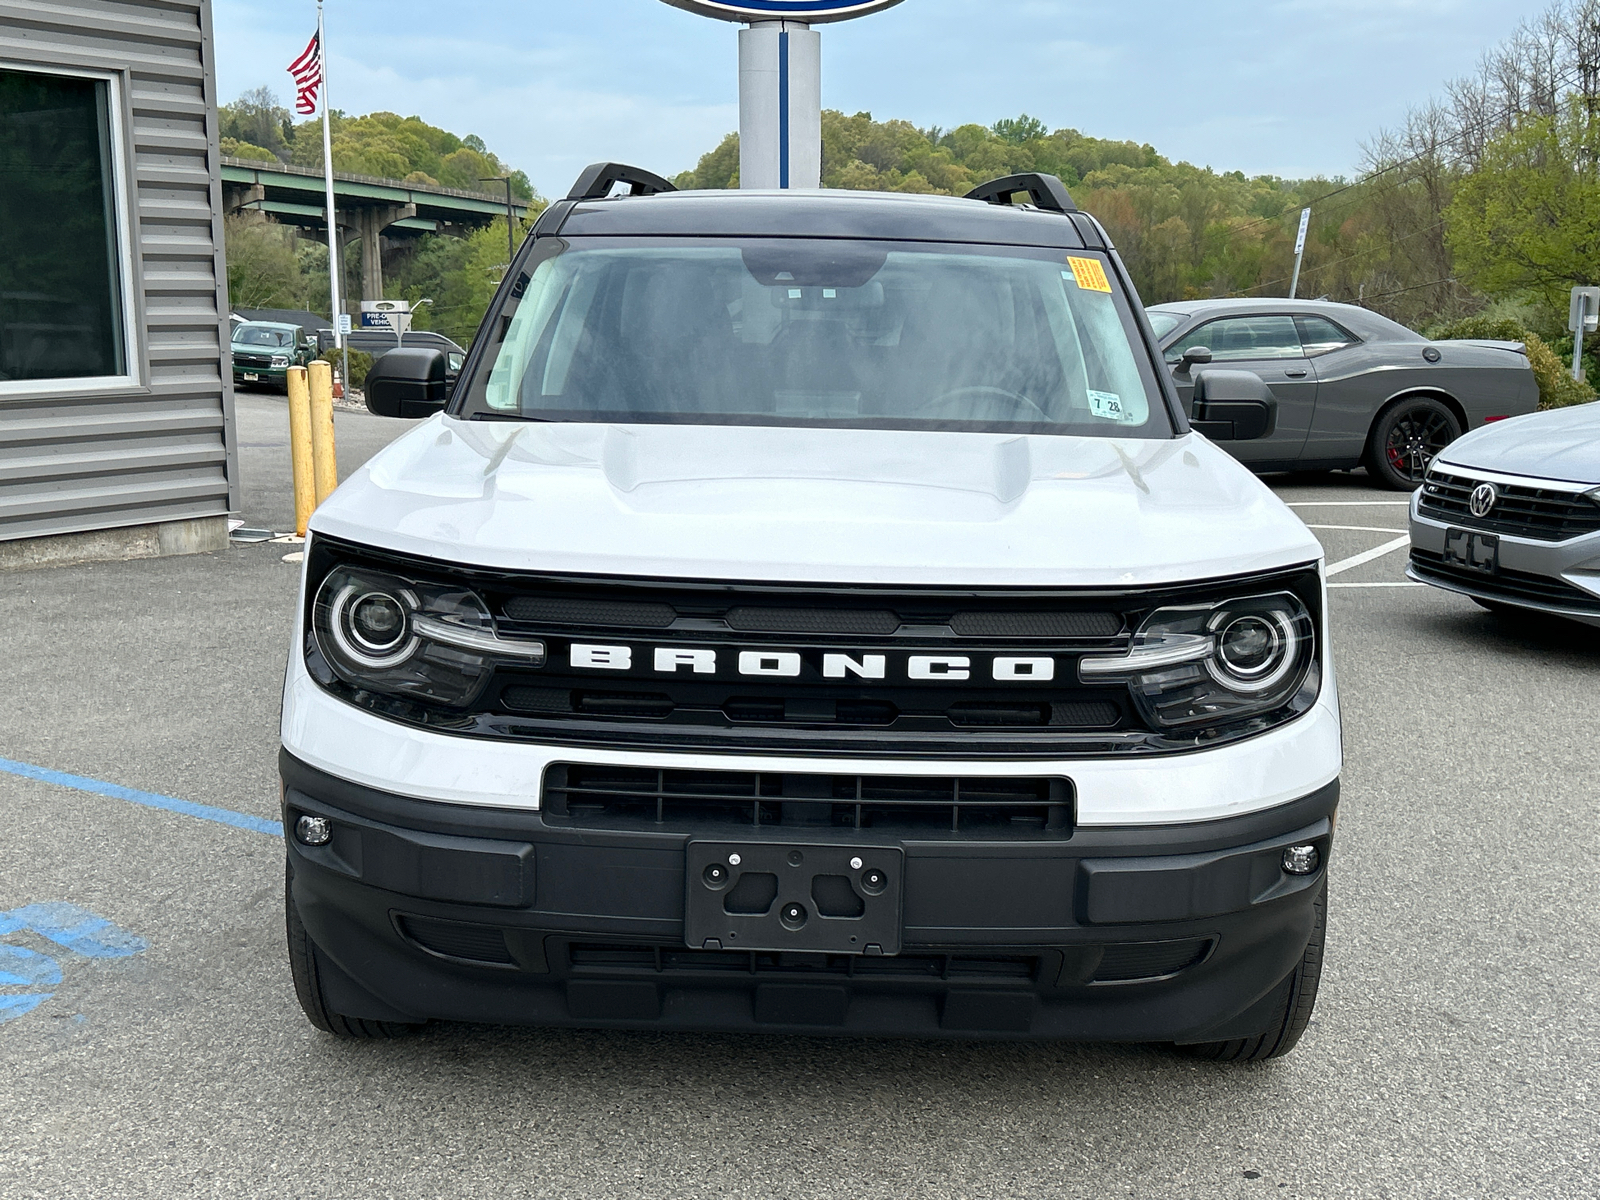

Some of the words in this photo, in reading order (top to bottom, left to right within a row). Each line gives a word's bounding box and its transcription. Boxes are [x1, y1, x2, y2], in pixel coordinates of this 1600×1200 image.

[1094, 398, 1100, 409] 7
[1107, 400, 1120, 412] 28
[570, 643, 1055, 681] BRONCO
